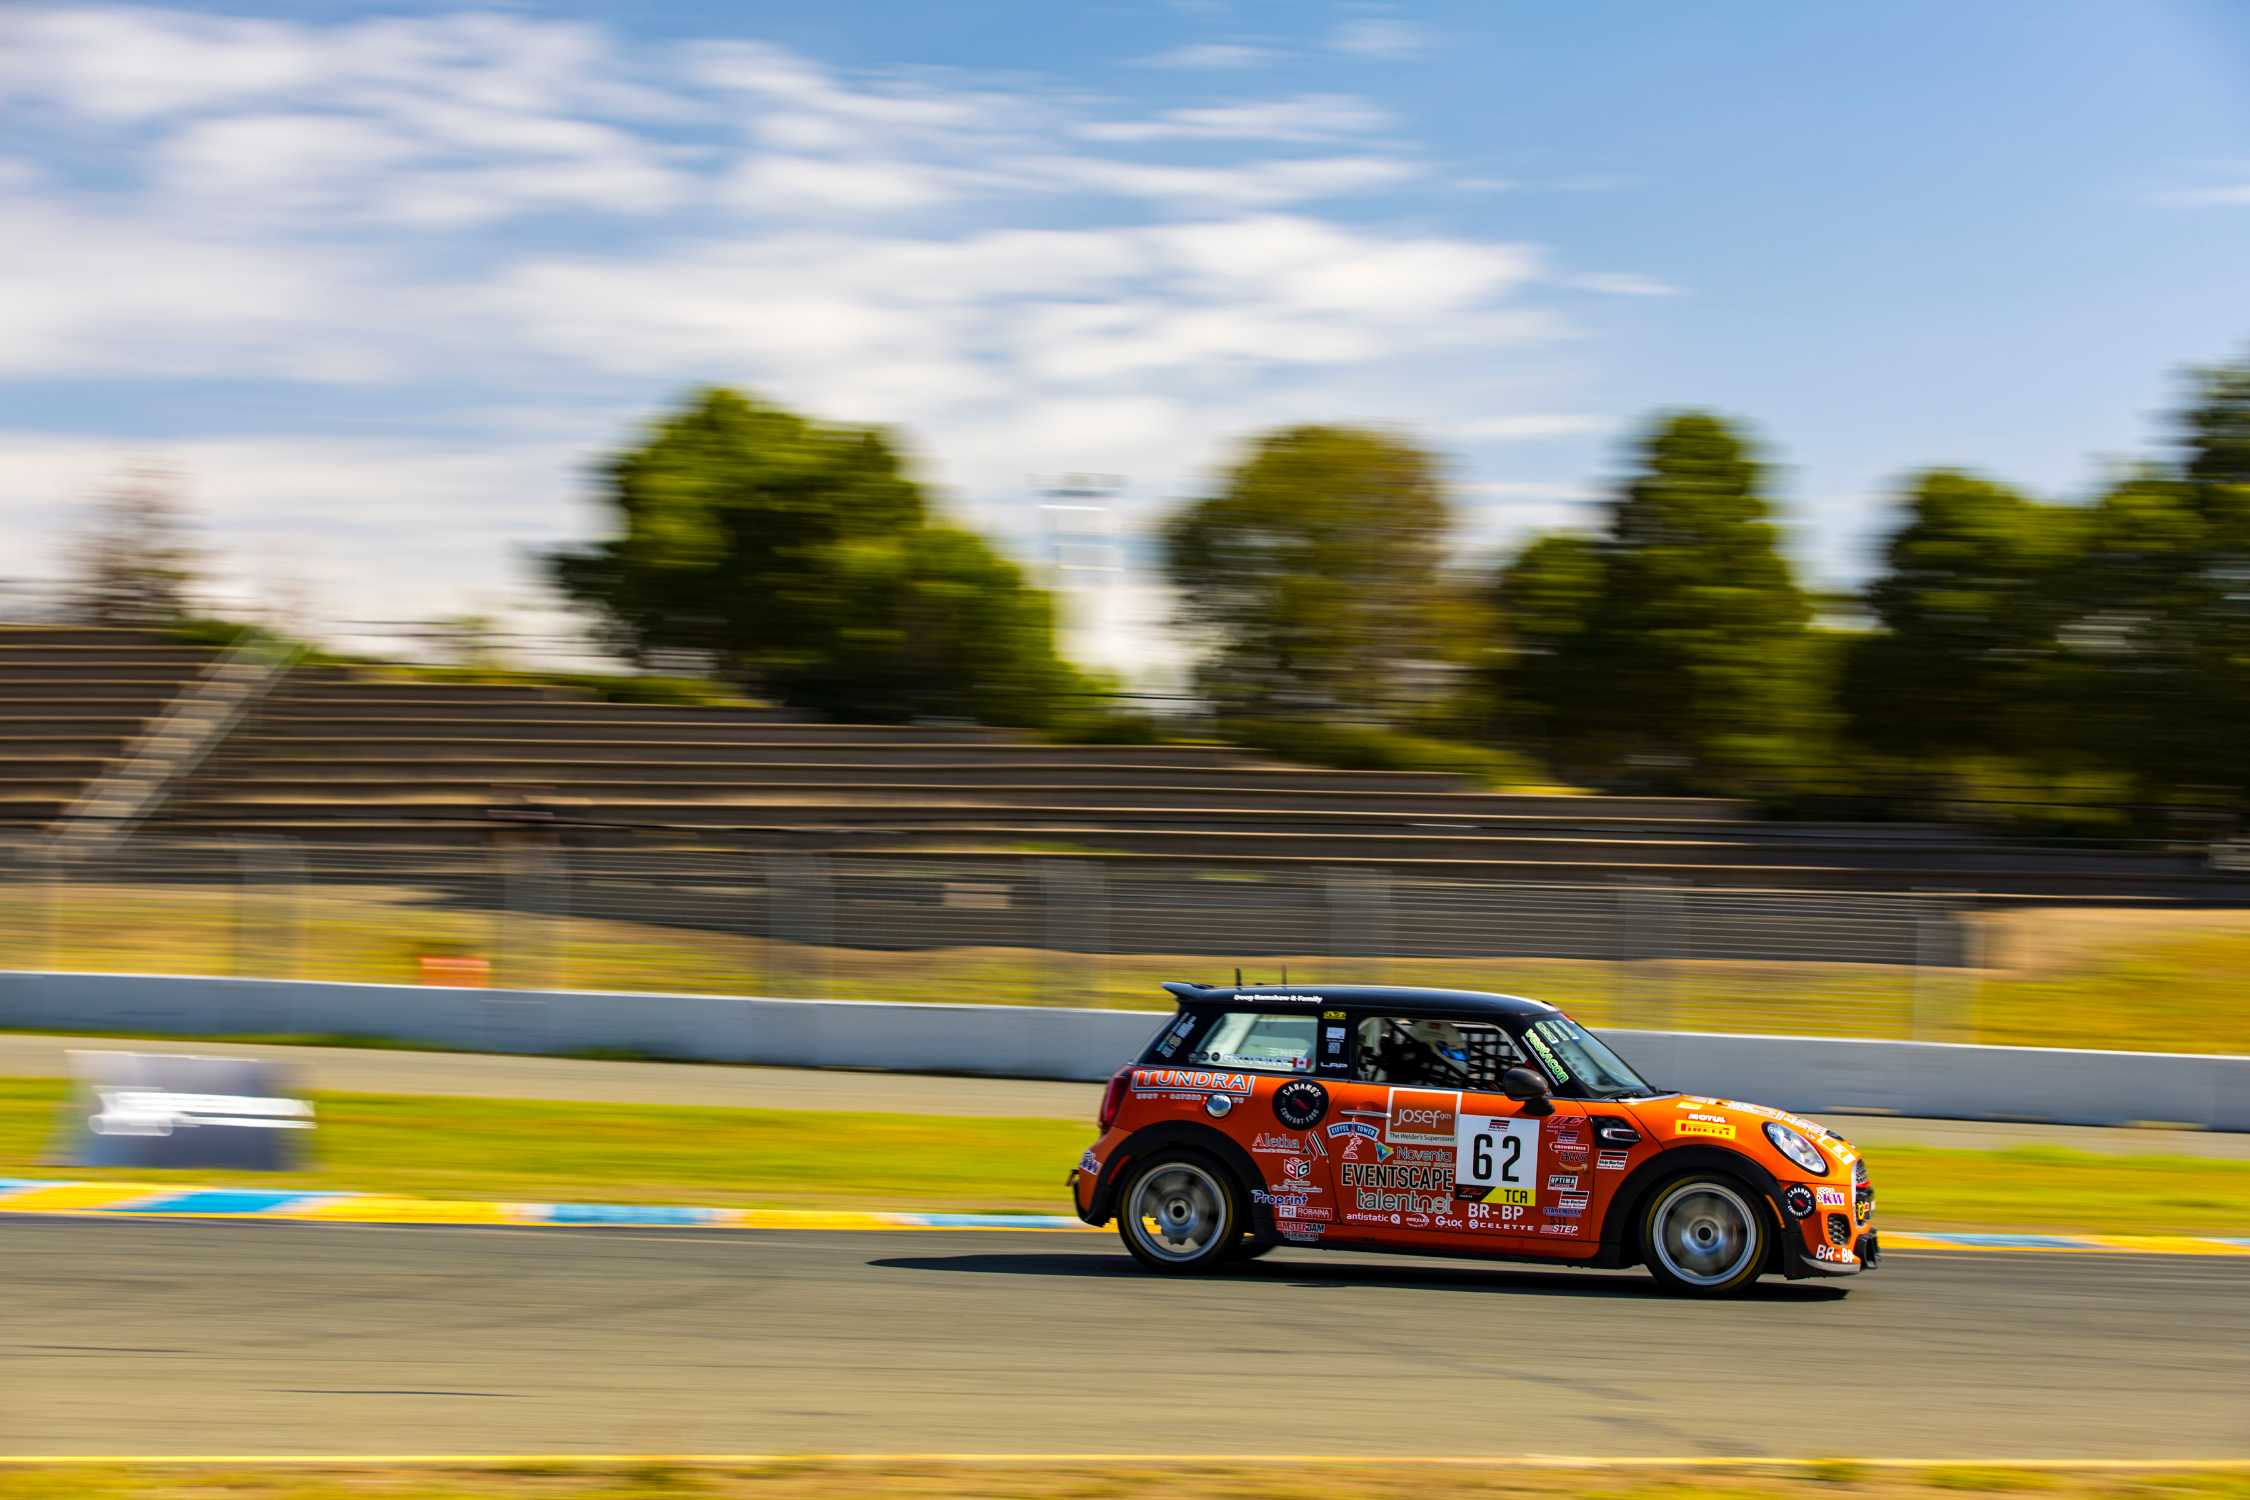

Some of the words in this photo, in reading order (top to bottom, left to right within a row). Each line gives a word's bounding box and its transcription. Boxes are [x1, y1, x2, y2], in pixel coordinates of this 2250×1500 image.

[1139, 1070, 1246, 1090] TUNDRA
[1688, 1113, 1726, 1123] MOTUL
[1331, 1125, 1349, 1136] EIFFEL
[1357, 1125, 1376, 1137] TOWER
[1473, 1133, 1521, 1182] 62
[1341, 1163, 1454, 1192] EVENTSCAPE
[1504, 1189, 1528, 1204] TCA
[1346, 1213, 1389, 1222] antistatic
[1480, 1221, 1535, 1231] CELETTE
[1552, 1225, 1578, 1234] STEP
